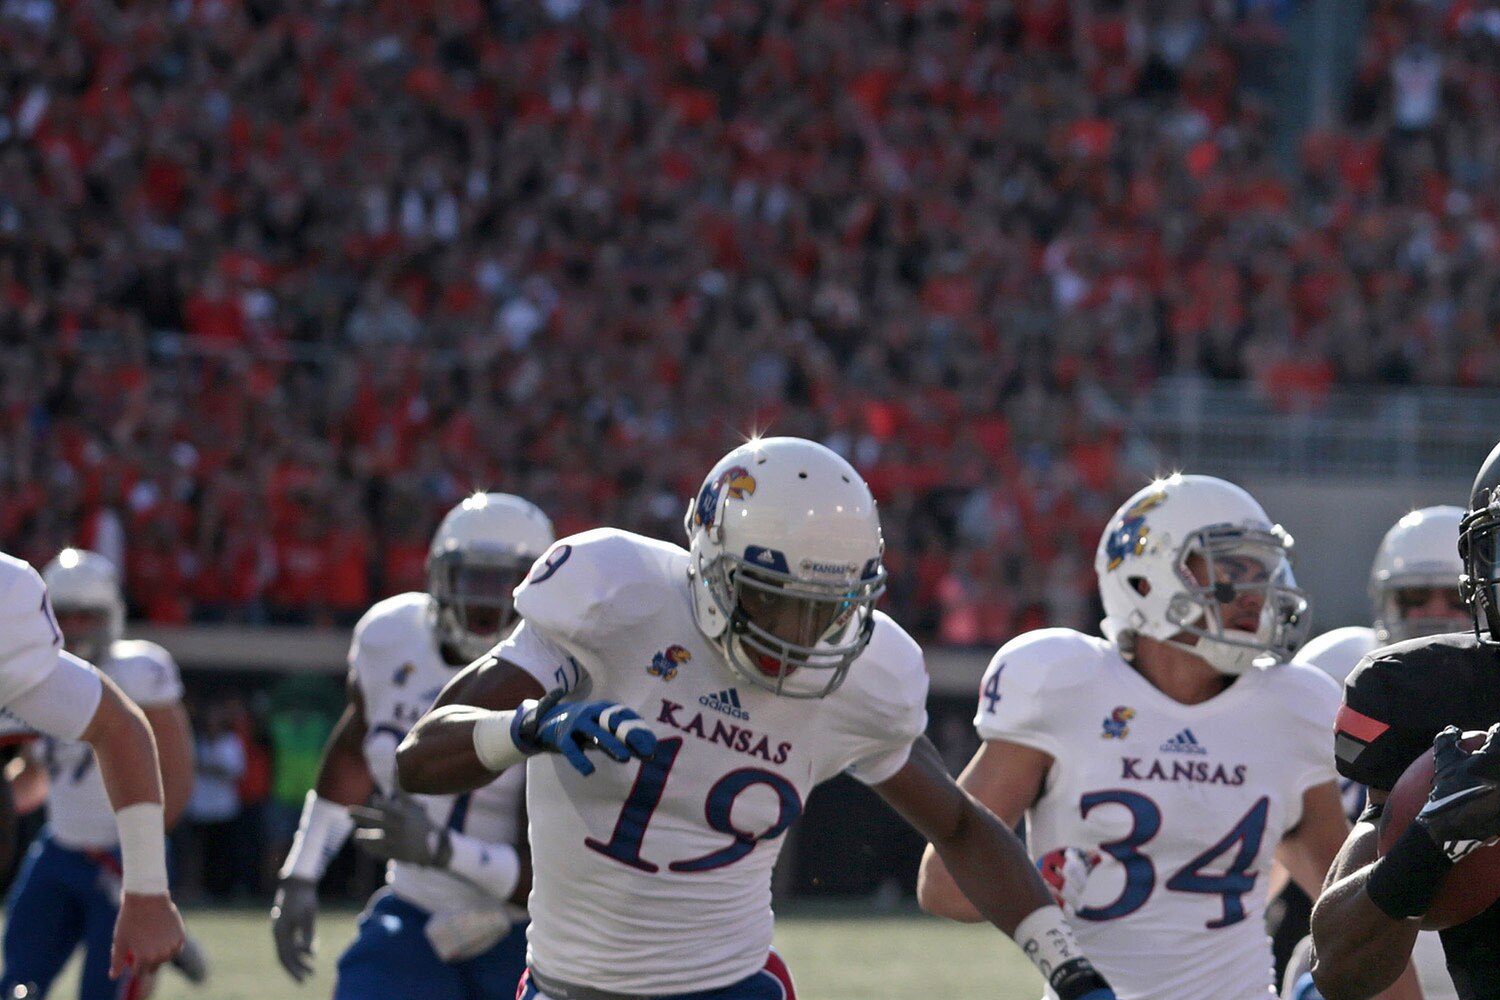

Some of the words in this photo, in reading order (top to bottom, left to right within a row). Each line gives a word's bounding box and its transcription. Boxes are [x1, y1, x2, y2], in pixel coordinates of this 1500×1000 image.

[656, 698, 793, 765] KANSAS
[698, 693, 750, 721] adidas
[584, 735, 803, 874] 19
[1120, 756, 1248, 787] KANSAS
[1075, 788, 1271, 929] 34
